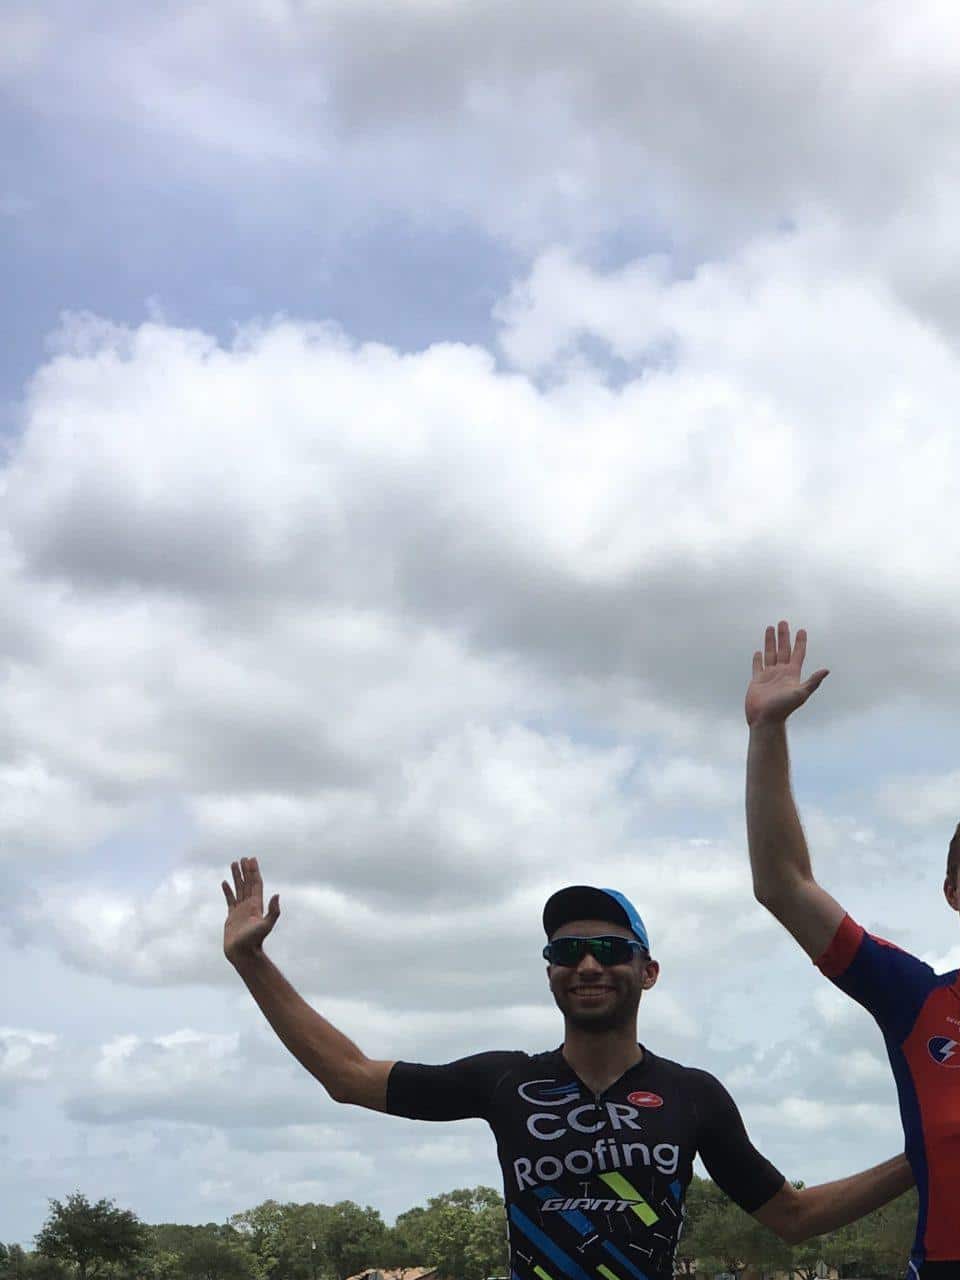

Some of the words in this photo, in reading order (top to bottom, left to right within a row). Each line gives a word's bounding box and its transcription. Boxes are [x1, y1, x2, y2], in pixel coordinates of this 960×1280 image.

[526, 1101, 643, 1141] CCR
[513, 1137, 680, 1192] Roofing
[541, 1198, 639, 1212] GIANT
